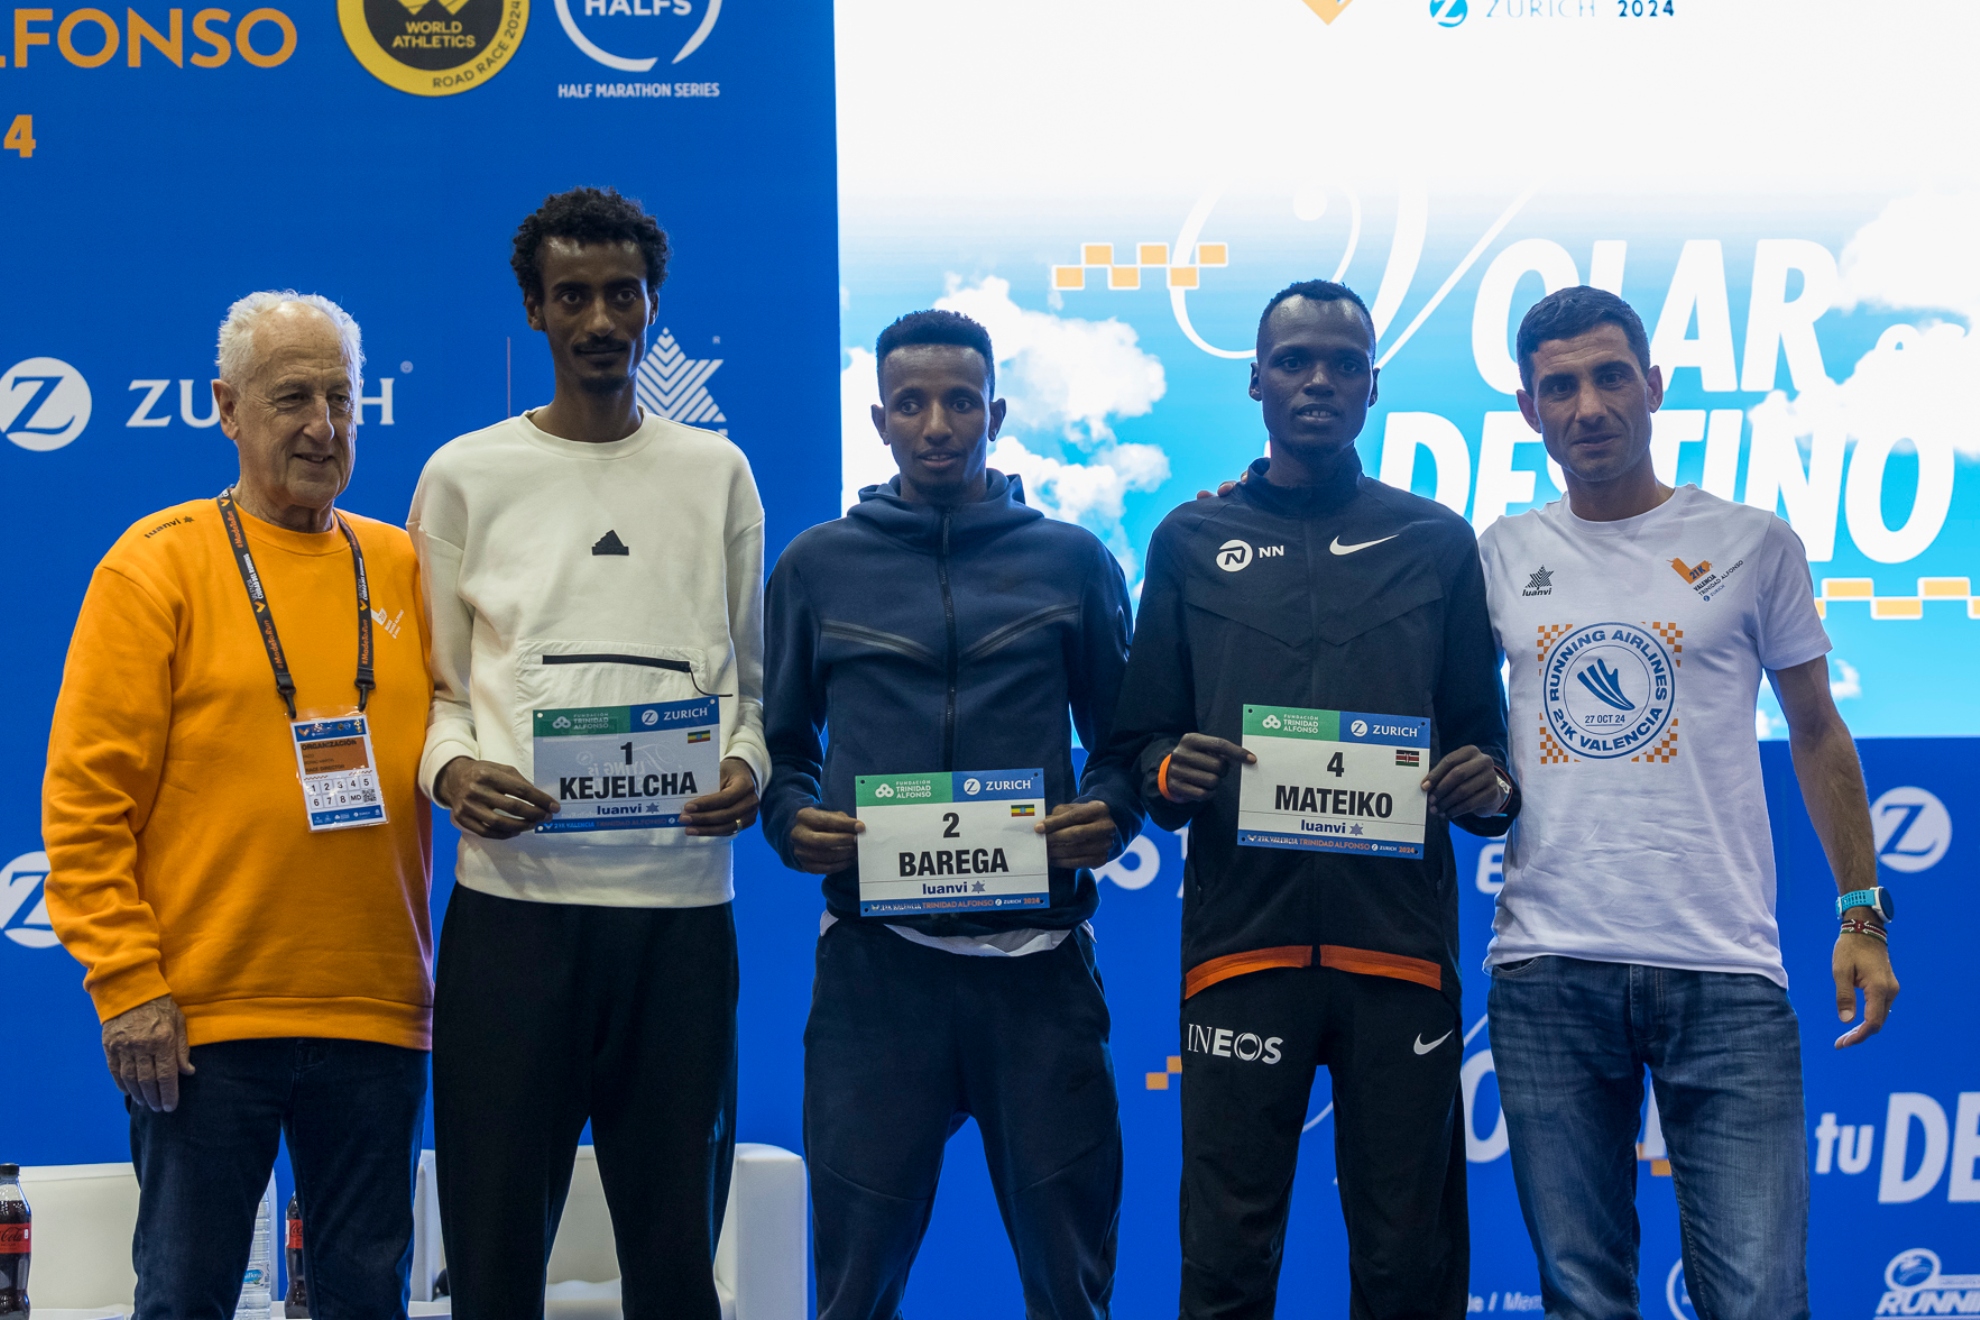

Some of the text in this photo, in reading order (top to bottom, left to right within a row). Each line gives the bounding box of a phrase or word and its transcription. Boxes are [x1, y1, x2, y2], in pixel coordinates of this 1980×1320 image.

[1618, 0, 1674, 17] 2024
[405, 21, 463, 34] WORLD
[0, 7, 298, 68] FONSO
[391, 35, 477, 48] ATHLETICS
[432, 69, 475, 89] ROAD
[475, 40, 510, 74] RACE
[558, 82, 721, 98] HALF MARATHON SERIES
[144, 518, 182, 539] luanvi
[1258, 545, 1285, 559] NN
[1689, 565, 1706, 580] 21K
[1698, 560, 1744, 597] TRINIDAD ALFONSO
[1693, 574, 1717, 592] VALENCIA
[1521, 586, 1553, 597] luanvi
[1549, 629, 1667, 702] RUNNING AIRLINES
[663, 707, 708, 721] ZURICH
[1585, 714, 1625, 723] 27 OCT 24
[1283, 719, 1319, 727] TRINIDAD
[1283, 725, 1319, 734] ALFONSO
[1553, 708, 1663, 751] 21K VALENCIA
[1372, 725, 1418, 738] ZURICH
[620, 741, 633, 765] 1
[1326, 751, 1345, 778] 4
[311, 784, 316, 792] 1
[364, 778, 369, 786] 5
[559, 771, 698, 800] KEJELCHA
[985, 780, 1032, 791] ZURICH
[896, 791, 932, 799] ALFONSO
[1275, 785, 1393, 818] MATEIKO
[314, 799, 319, 807] 6
[597, 803, 642, 815] luanvi
[942, 812, 960, 838] 2
[1301, 819, 1346, 834] luanvi
[1299, 838, 1335, 848] TRINIDAD
[1335, 840, 1370, 850] ALFONSO
[899, 848, 1009, 877] BAREGA
[922, 882, 967, 894] luanvi
[922, 901, 957, 909] TRINIDAD
[957, 899, 994, 907] ALFONSO
[1187, 1023, 1284, 1065] INEOS
[1815, 1112, 1875, 1175] tu
